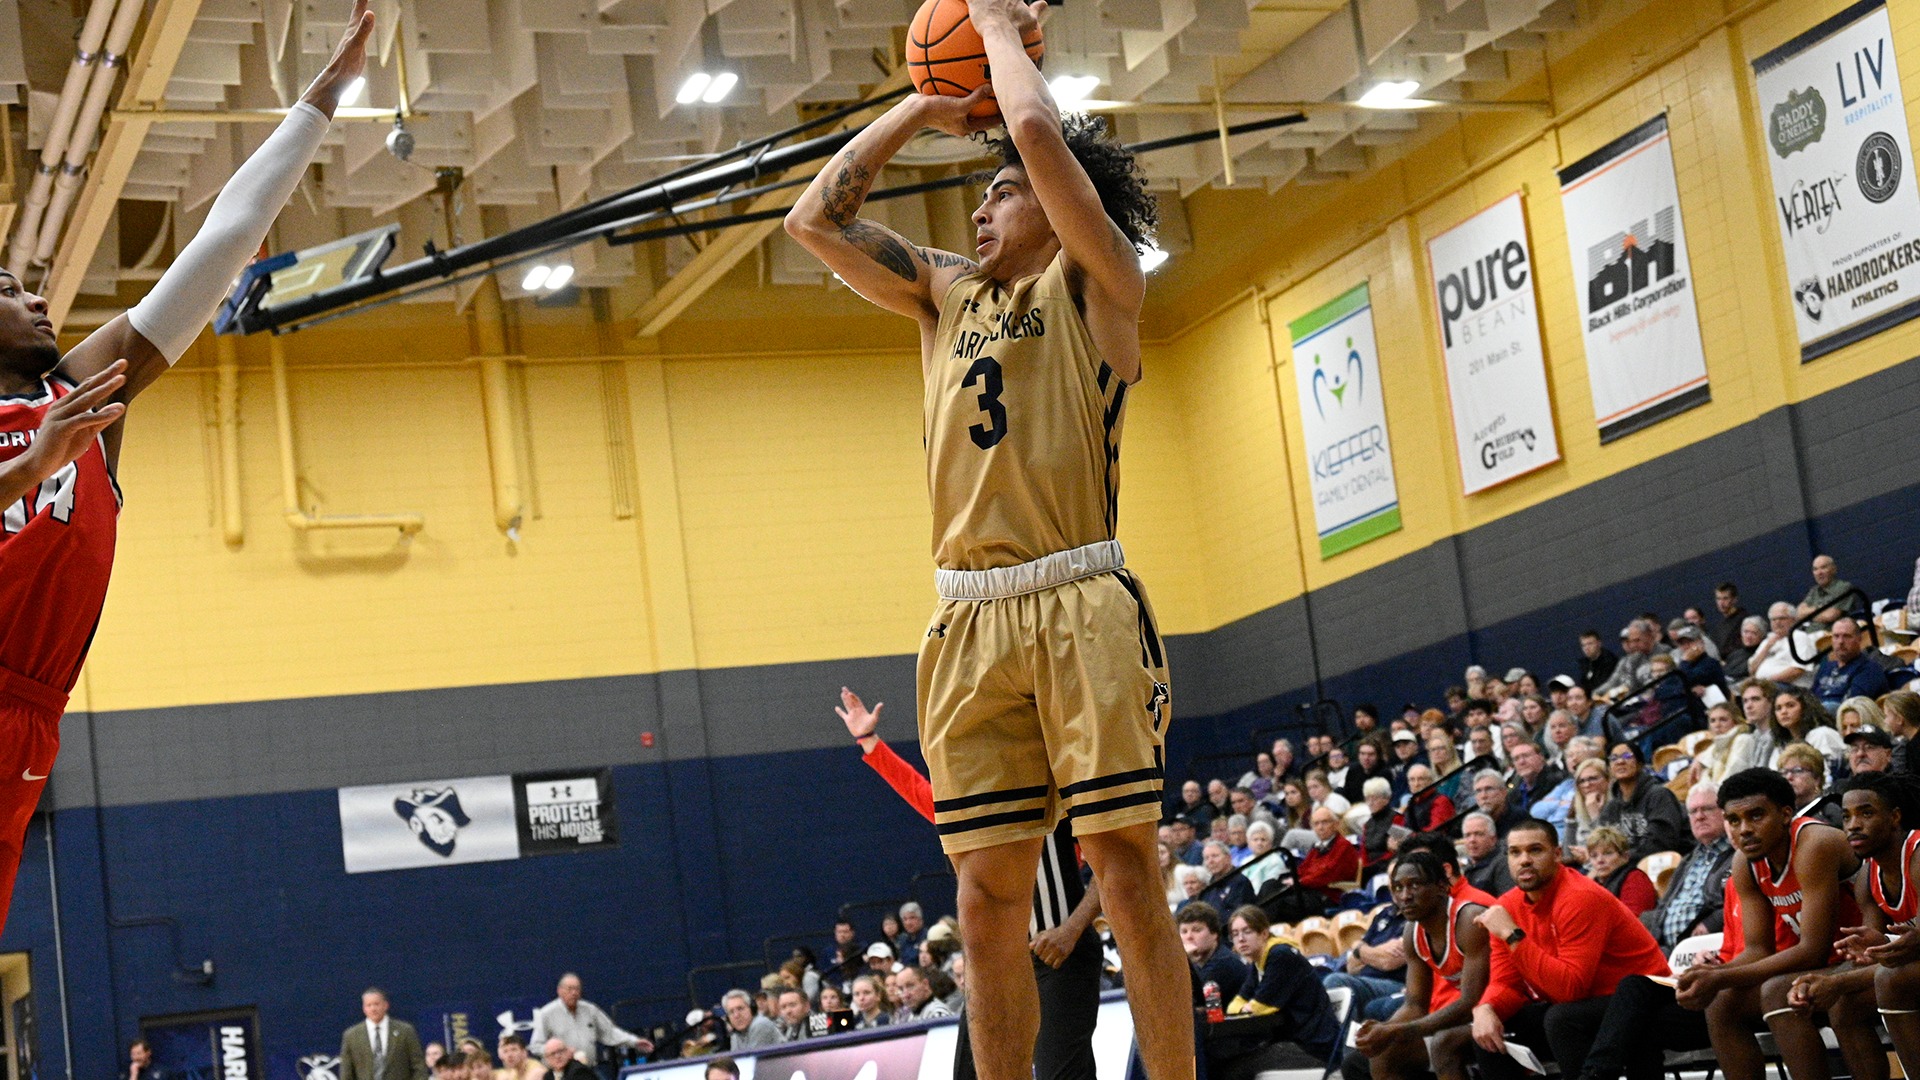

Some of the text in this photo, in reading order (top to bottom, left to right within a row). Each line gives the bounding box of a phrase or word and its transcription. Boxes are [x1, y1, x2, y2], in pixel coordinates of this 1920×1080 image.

[1836, 38, 1884, 109] LIV
[1778, 99, 1814, 131] PADDY
[1844, 93, 1894, 126] HOSPITALITY
[1826, 238, 1920, 299] HARDROCKERS
[1438, 240, 1527, 349] pure
[1589, 311, 1611, 333] Black
[1613, 303, 1632, 321] Hills
[1633, 277, 1687, 312] Corporation
[1851, 279, 1899, 310] ATHLETICS
[1462, 297, 1526, 345] BEAN
[1487, 349, 1509, 366] Main
[961, 356, 1008, 450] 3
[1312, 424, 1386, 481] KIEFFER
[528, 801, 602, 825] PROTECT
[530, 823, 559, 841] THIS
[220, 1026, 248, 1080] HAR
